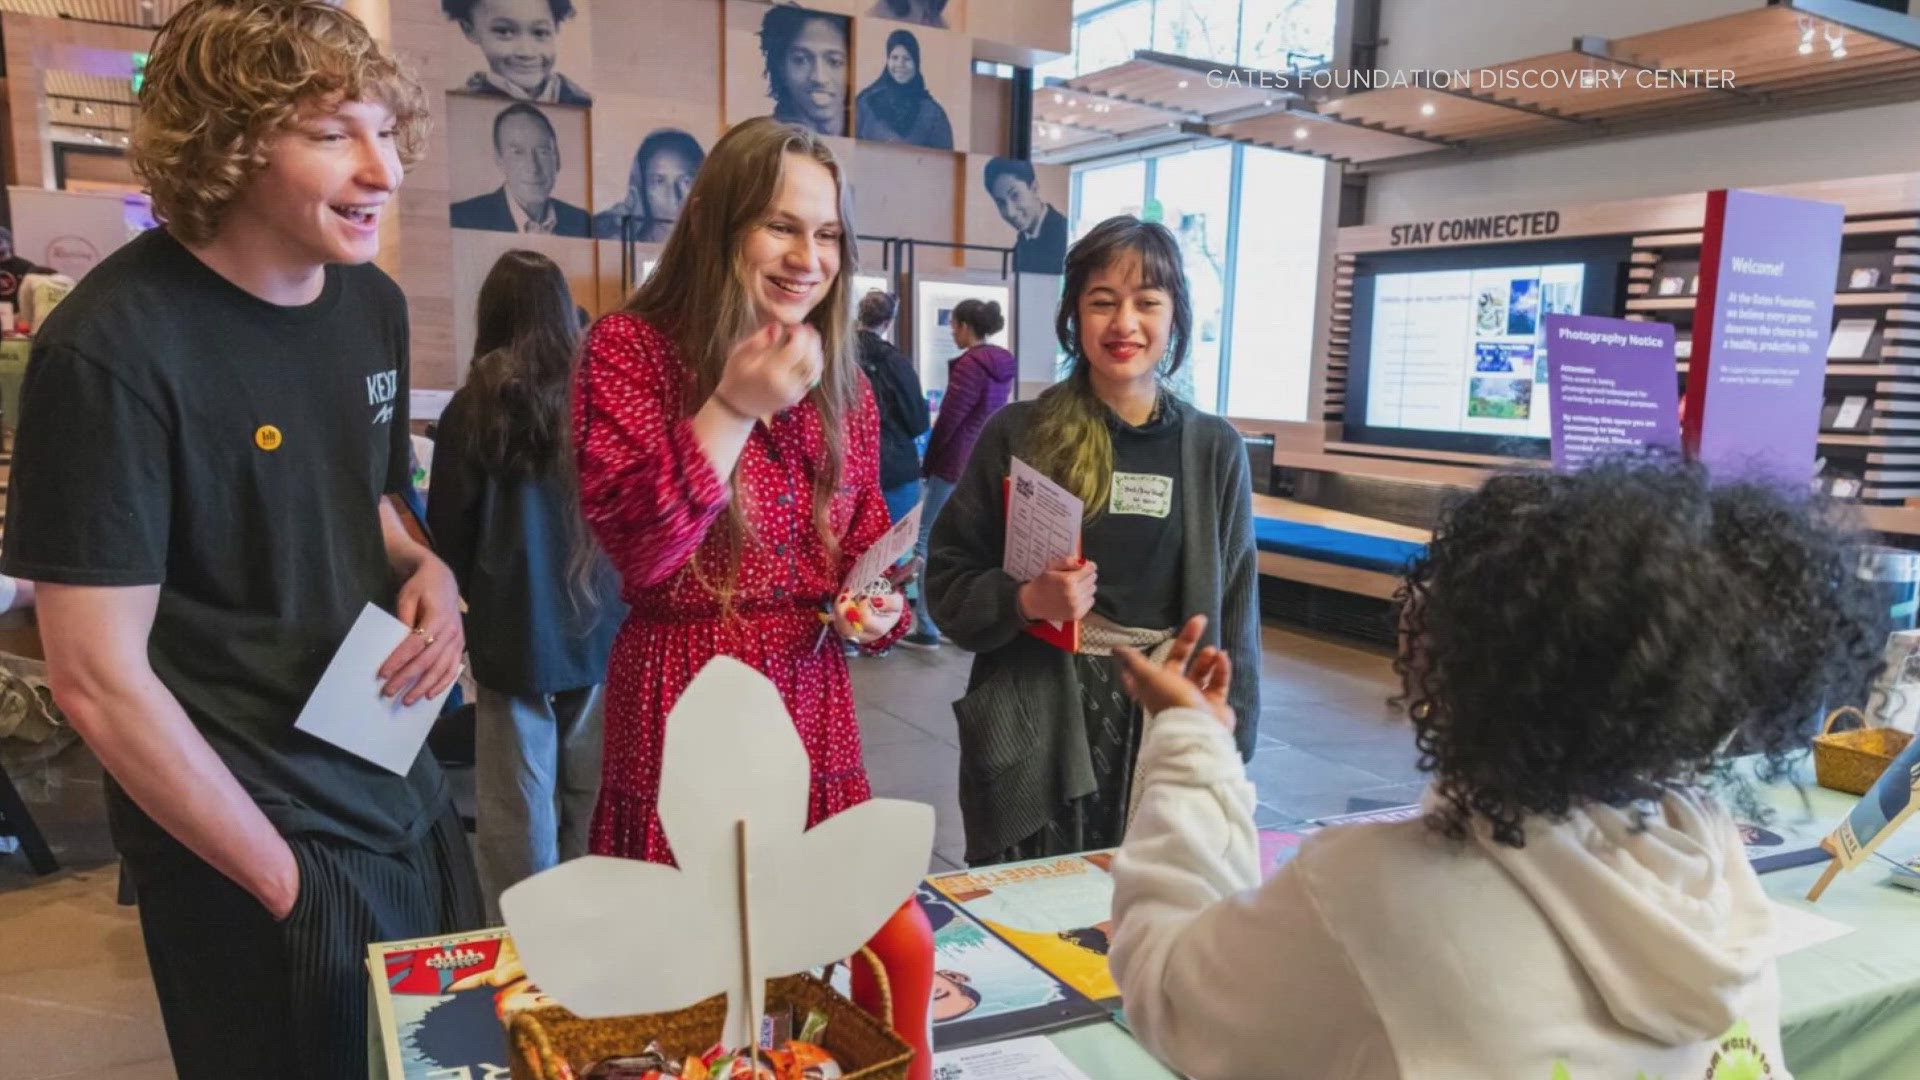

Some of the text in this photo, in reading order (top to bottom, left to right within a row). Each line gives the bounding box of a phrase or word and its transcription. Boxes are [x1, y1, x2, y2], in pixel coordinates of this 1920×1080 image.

[1390, 210, 1560, 246] STAY CONNECTED
[1732, 256, 1784, 276] Welcome!
[1738, 292, 1751, 304] the
[1786, 313, 1812, 324] person
[1558, 327, 1664, 349] Photography Notice
[1759, 325, 1772, 337] the
